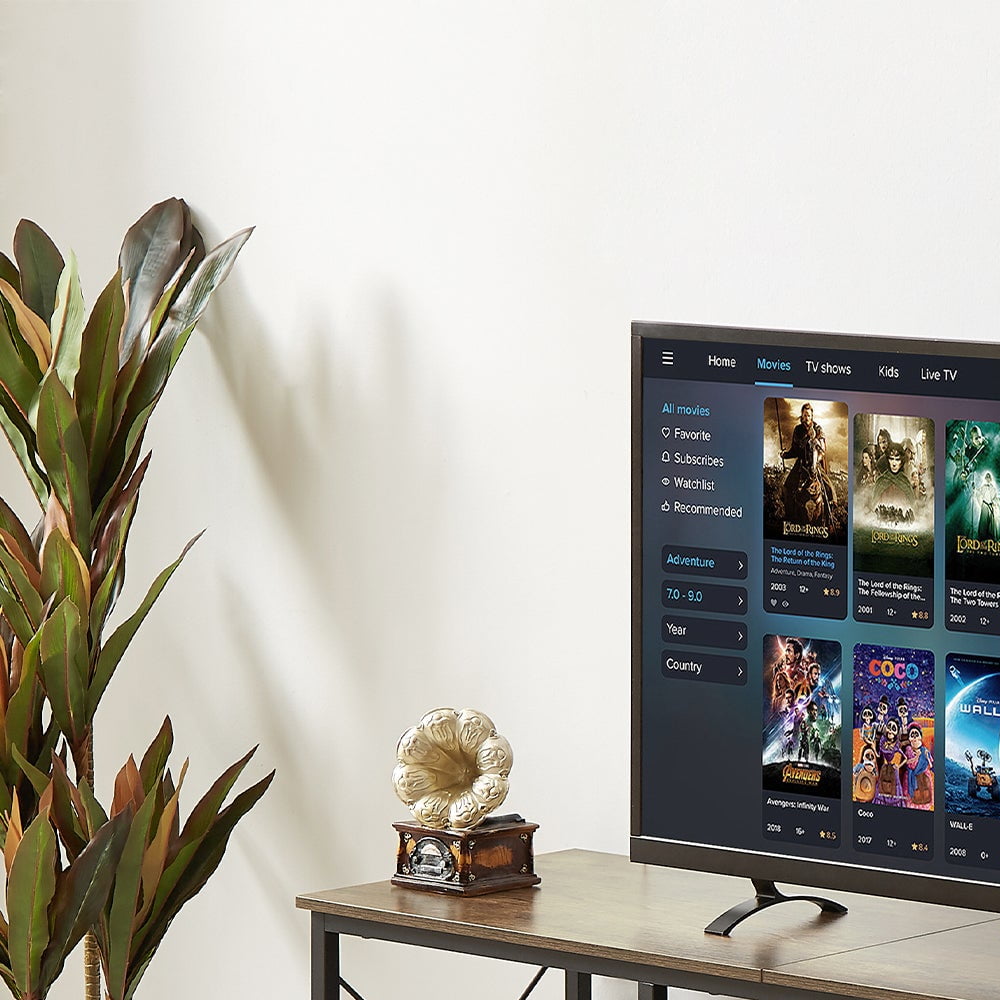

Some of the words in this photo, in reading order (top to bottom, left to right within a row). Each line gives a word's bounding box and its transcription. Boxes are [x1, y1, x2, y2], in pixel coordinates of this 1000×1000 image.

[708, 355, 736, 368] Home
[757, 358, 791, 371] Movies
[806, 361, 819, 373] TV
[820, 362, 852, 375] shows
[878, 365, 899, 378] Kids
[921, 368, 940, 381] Live
[942, 370, 957, 382] TV
[662, 403, 674, 414] All
[677, 405, 710, 417] movies
[674, 427, 711, 441] Favorite
[674, 452, 724, 467] Subscribes
[674, 476, 715, 491] Watchlist
[674, 501, 743, 517] Recommended
[667, 553, 715, 568] Adventure
[770, 583, 787, 591] 2003
[858, 579, 869, 587] The
[871, 580, 884, 588] Lord
[666, 588, 680, 600] 7.0
[688, 590, 703, 602] 9.0
[858, 588, 869, 596] The
[950, 587, 961, 596] The
[963, 589, 977, 597] Lord
[950, 596, 961, 605] The
[963, 598, 976, 606] Two
[977, 599, 999, 608] Towers
[858, 606, 873, 614] 2001
[950, 615, 966, 623] 2002
[666, 623, 687, 635] Year
[666, 658, 702, 675] Country
[868, 659, 919, 680] COCO
[857, 809, 874, 818] Coco
[858, 836, 872, 844] 2017
